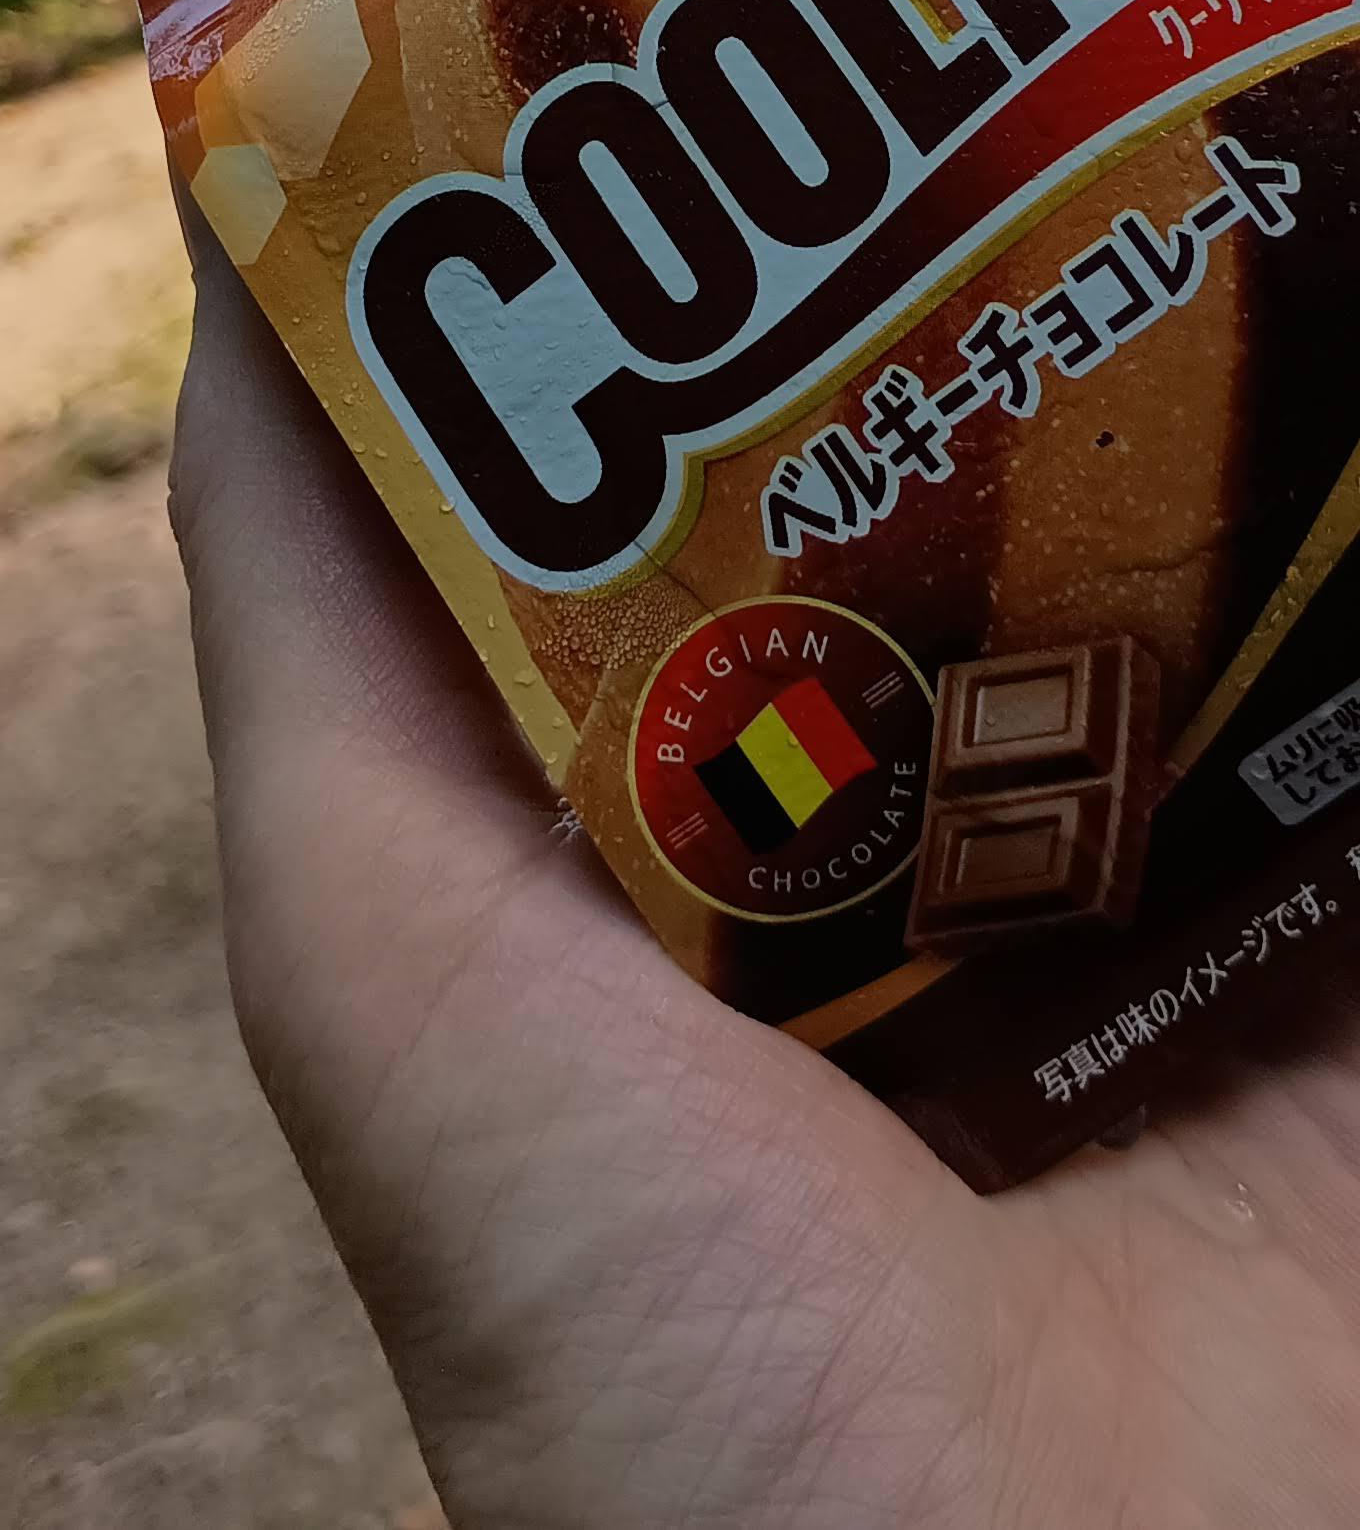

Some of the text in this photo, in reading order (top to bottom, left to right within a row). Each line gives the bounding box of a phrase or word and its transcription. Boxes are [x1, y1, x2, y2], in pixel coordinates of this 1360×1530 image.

[768, 142, 1290, 550] ベルギーチョコレート
[657, 627, 829, 764] BELGIAN
[748, 762, 917, 893] CHOCOLATE
[1034, 882, 1338, 1104] 写真は味のイメージです。
